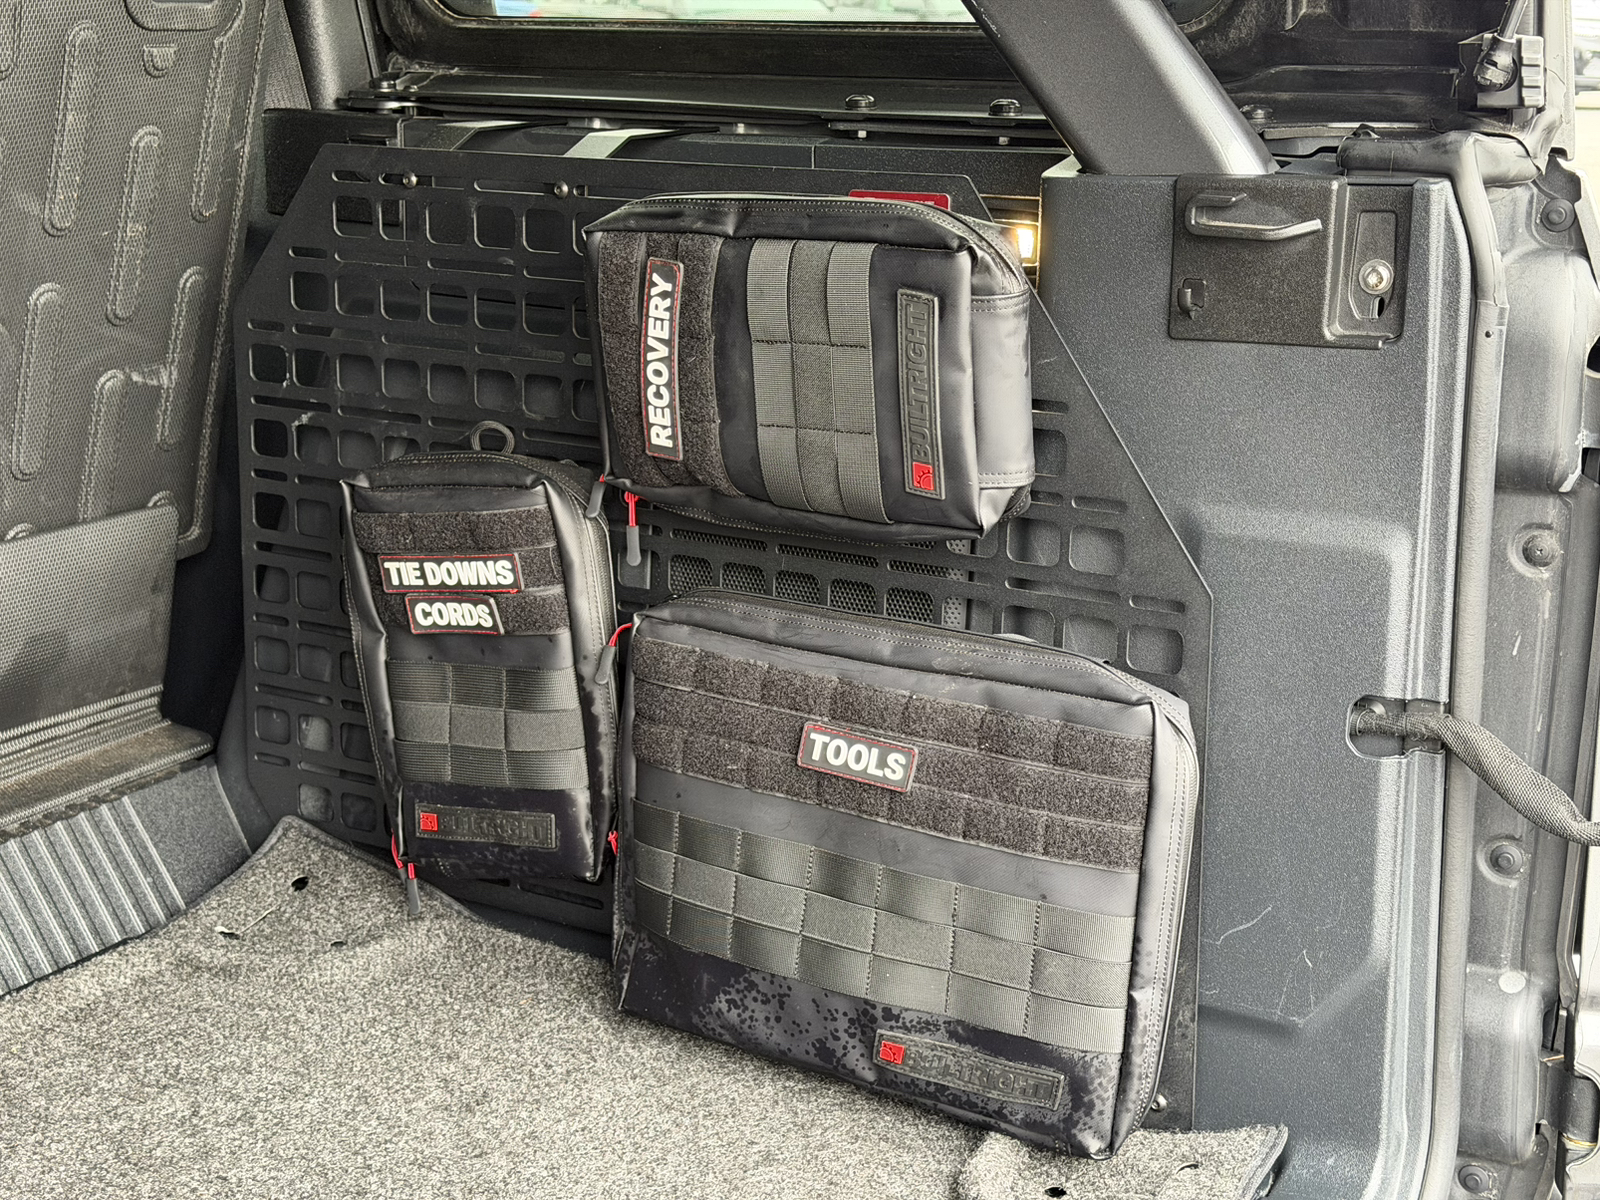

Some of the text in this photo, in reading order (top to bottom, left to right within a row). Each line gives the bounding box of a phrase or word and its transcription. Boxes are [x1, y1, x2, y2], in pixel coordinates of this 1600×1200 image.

[646, 272, 673, 448] RECOVERY
[905, 303, 932, 464] BUILTRIGHT
[383, 560, 515, 586] TIE DOWNS
[414, 601, 494, 628] CORDS
[809, 732, 906, 781] TOOLS
